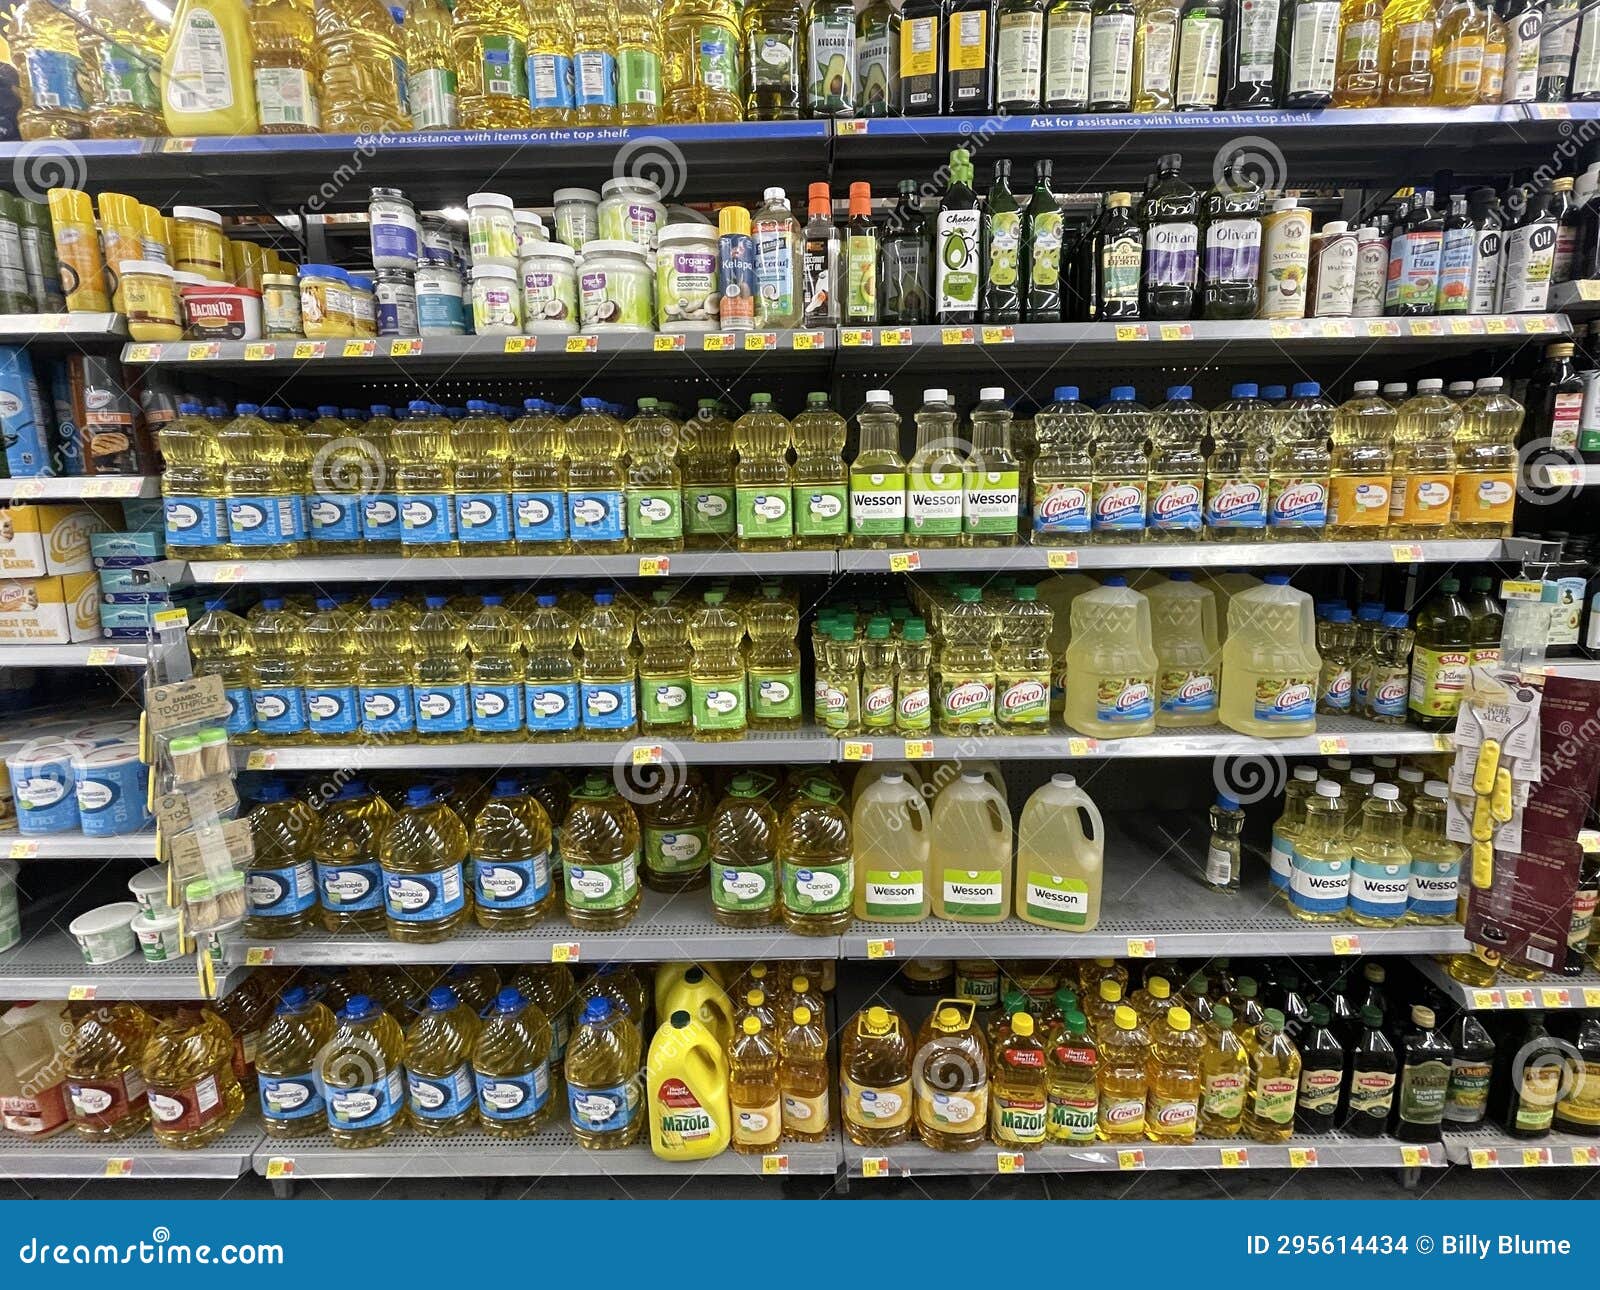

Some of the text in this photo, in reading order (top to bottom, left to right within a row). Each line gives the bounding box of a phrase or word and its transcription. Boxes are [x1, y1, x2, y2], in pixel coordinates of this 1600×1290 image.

[1030, 111, 1315, 128] Ask for assistance with items on the top shelf.
[354, 128, 631, 146] Ask for assistance with items on the top shelf.
[1155, 229, 1197, 244] Olivari
[1216, 227, 1258, 241] Olivari
[678, 256, 712, 267] Organic
[190, 301, 219, 317] BACON
[853, 494, 902, 506] Wesson
[912, 494, 961, 505] Wesson
[968, 493, 1017, 505] Wesson
[1043, 494, 1081, 516] Crisco
[1100, 493, 1137, 514] Crisco
[1157, 492, 1195, 513] Crisco
[1216, 491, 1256, 512] Crisco
[1278, 490, 1318, 511] Crisco
[1440, 654, 1467, 664] STAR
[1476, 651, 1499, 660] STAR
[949, 690, 987, 708] Crisco
[1004, 689, 1040, 708] Crisco
[1119, 689, 1148, 706] Crisco
[1279, 689, 1309, 705] Crisco
[873, 886, 915, 896] Wesson
[951, 885, 993, 896] Wesson
[1309, 877, 1348, 889] Wesso
[1364, 880, 1408, 892] Wesso
[1415, 878, 1457, 890] Wesso
[1034, 888, 1078, 904] Wesson
[1112, 1105, 1141, 1120] Crisco
[1163, 1106, 1194, 1122] Crisco
[662, 1112, 710, 1132] Mazola
